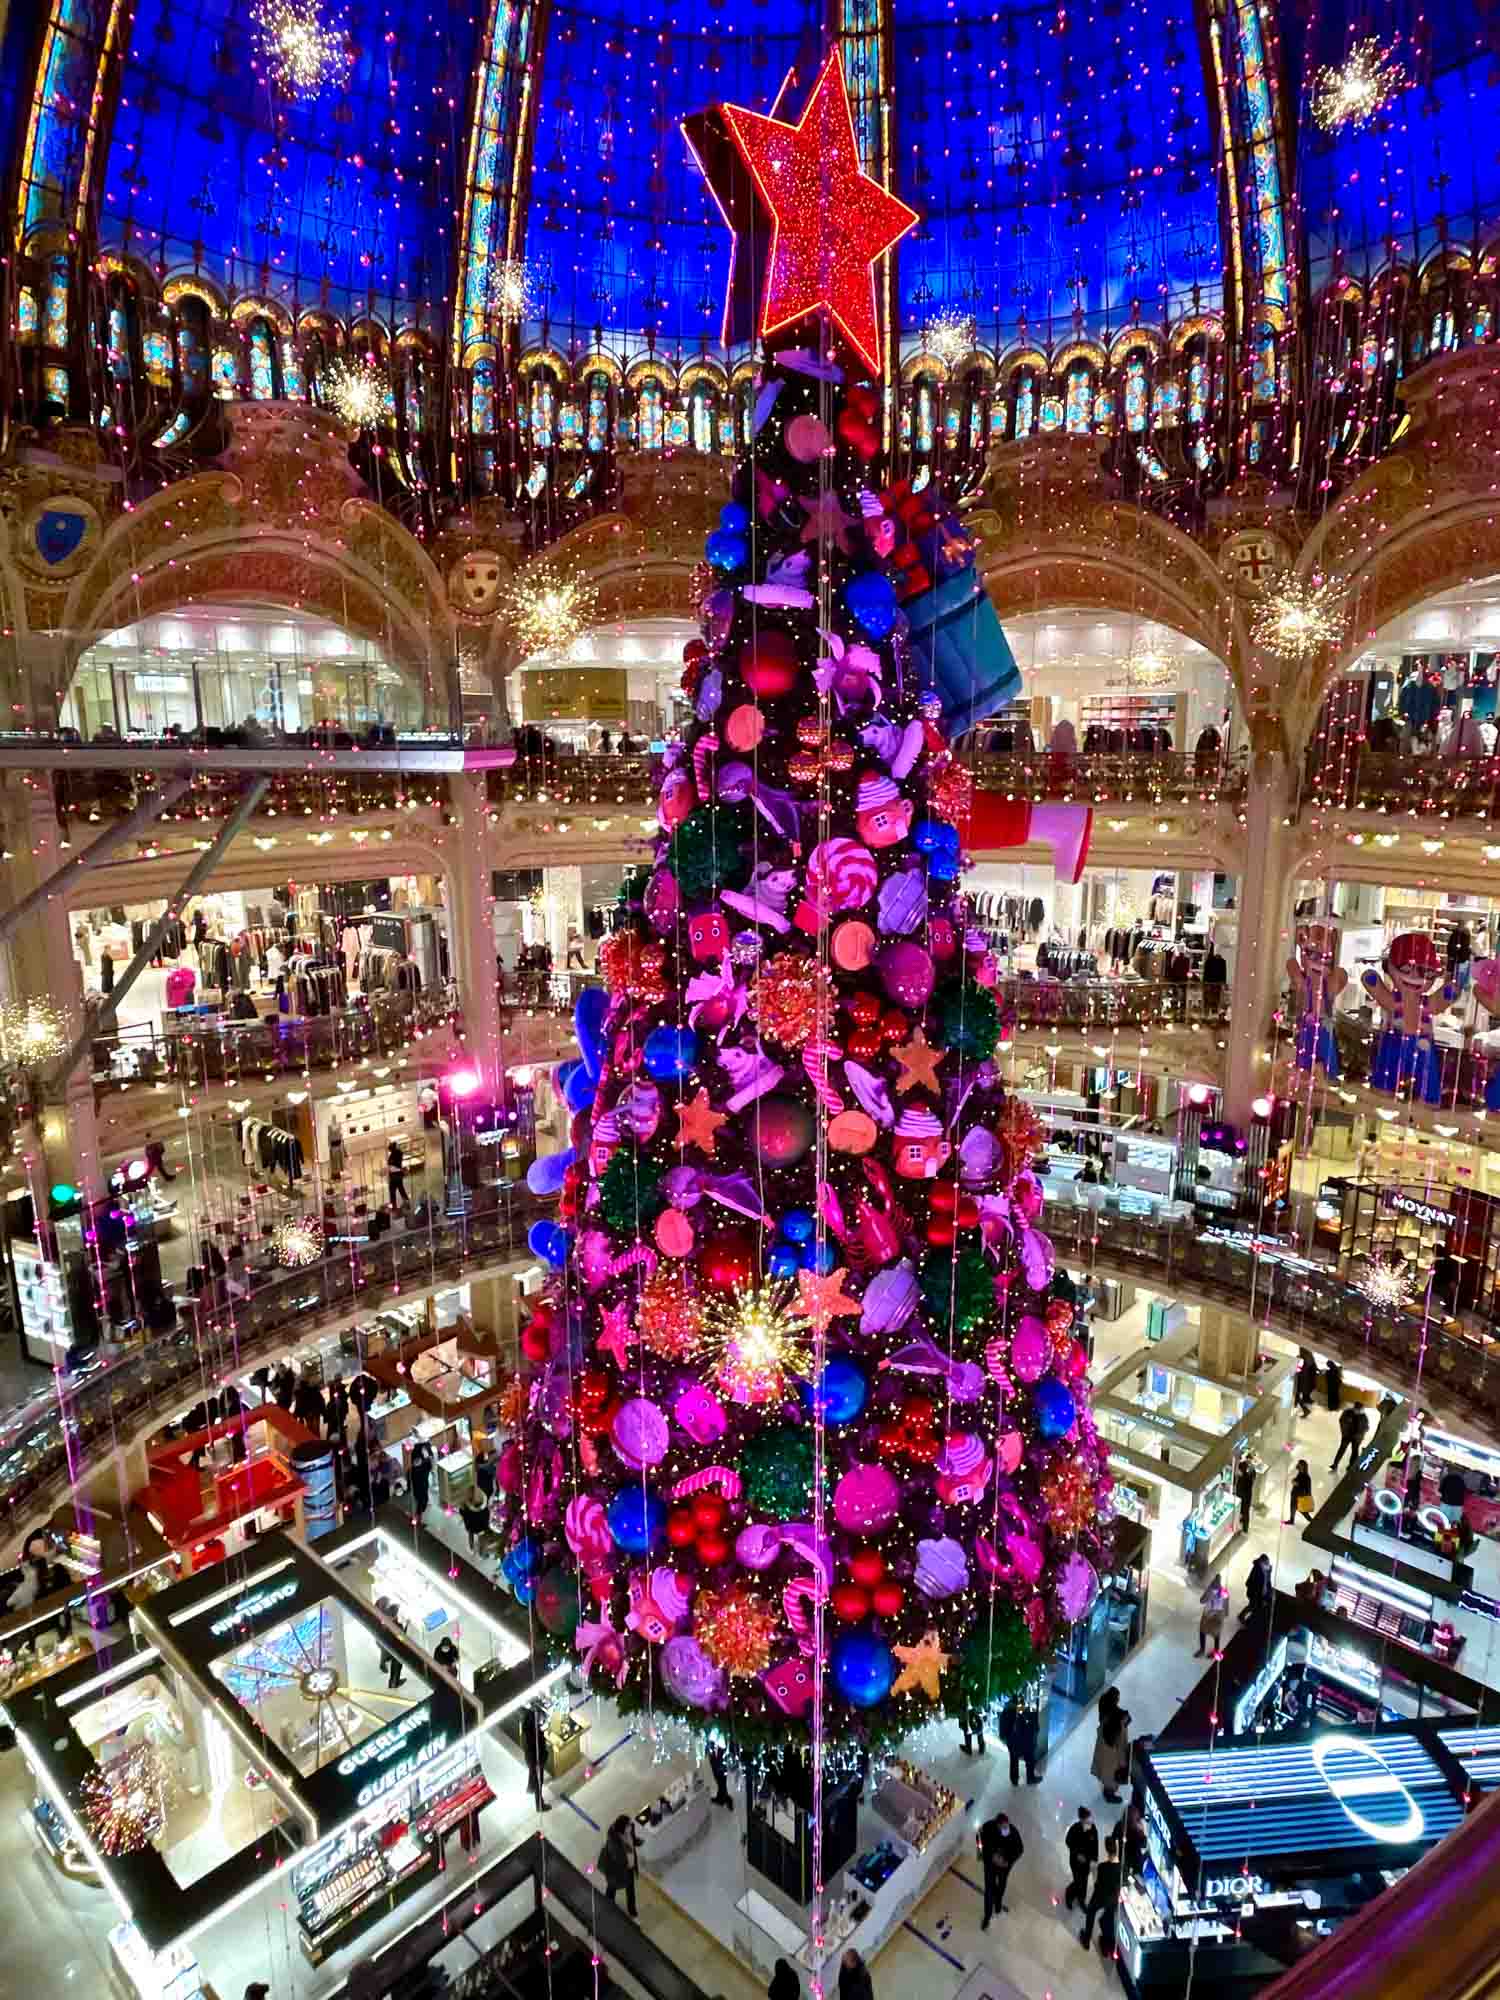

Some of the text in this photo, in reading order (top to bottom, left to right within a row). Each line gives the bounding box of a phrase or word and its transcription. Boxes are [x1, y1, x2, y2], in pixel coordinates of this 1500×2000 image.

[1392, 1194, 1456, 1226] MOYNAT
[210, 1581, 298, 1636] GUERLAIN
[337, 1706, 430, 1776] GUERLAIN
[357, 1732, 447, 1808] GUERLAIN
[1205, 1875, 1264, 1898] DIOR
